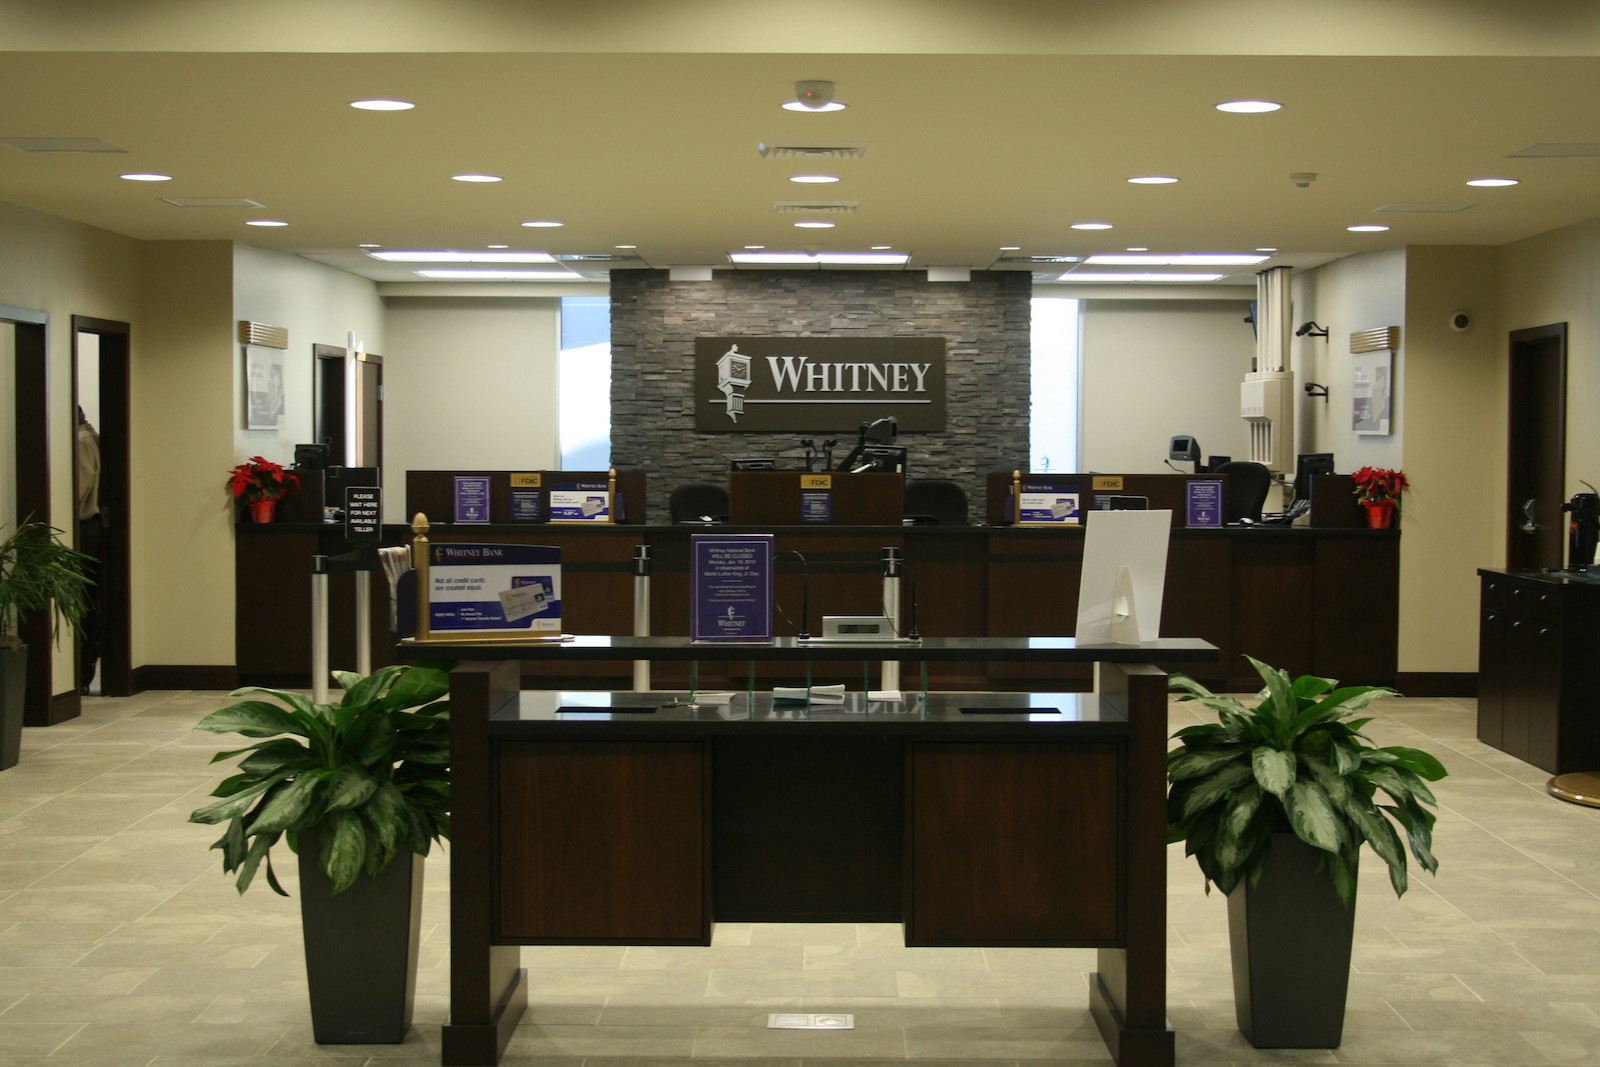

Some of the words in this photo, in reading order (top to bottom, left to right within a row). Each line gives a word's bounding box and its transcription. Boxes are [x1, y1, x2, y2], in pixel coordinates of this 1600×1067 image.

[765, 356, 932, 393] WHITNEY
[445, 548, 481, 556] WHITNEY
[482, 548, 504, 556] BANK
